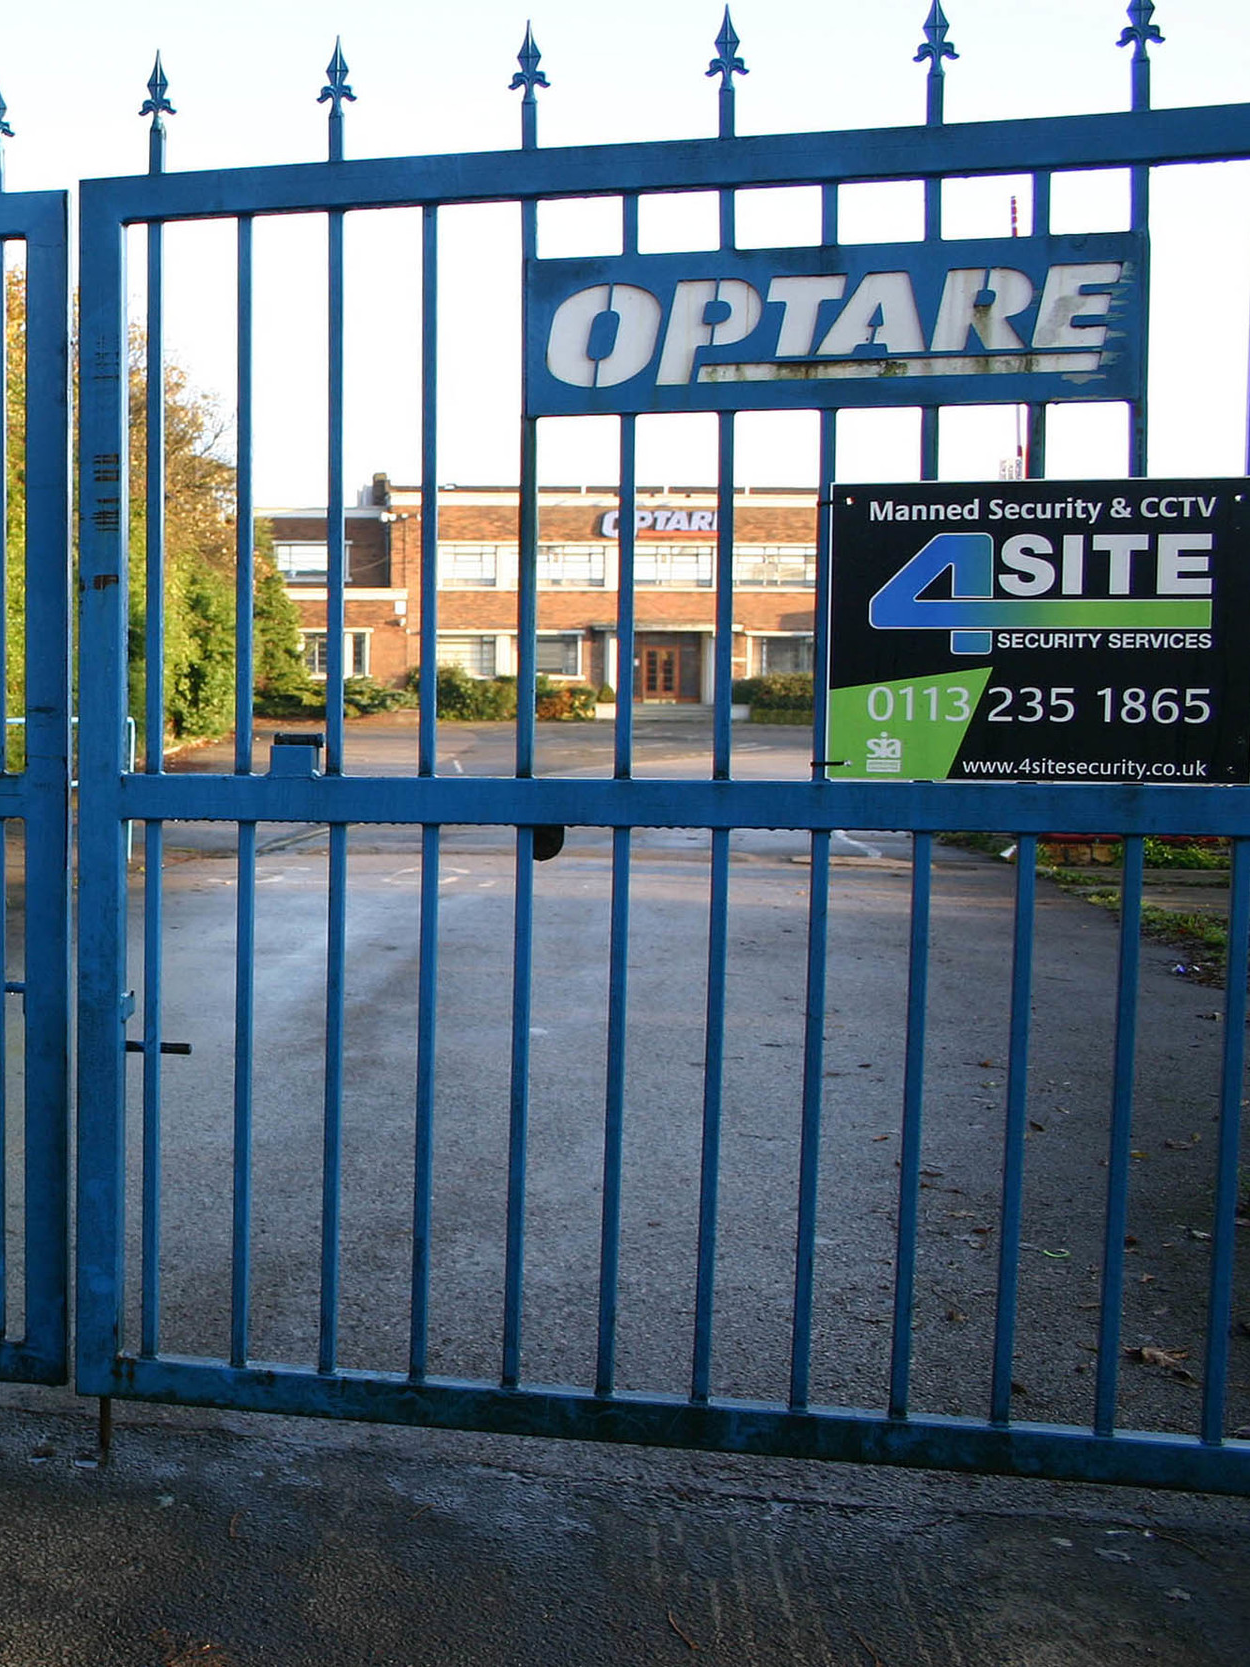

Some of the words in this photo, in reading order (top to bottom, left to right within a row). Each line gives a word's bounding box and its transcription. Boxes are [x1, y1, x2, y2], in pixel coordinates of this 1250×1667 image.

[545, 261, 1124, 388] OPTARE
[601, 510, 718, 538] OPTAR
[869, 499, 980, 522] Manned
[988, 498, 1102, 524] Security
[1109, 498, 1132, 519] &
[1140, 497, 1217, 518] CCTV
[997, 633, 1100, 650] SECURITY
[1108, 633, 1212, 650] SERVICES
[867, 686, 972, 723] 0113
[987, 687, 1075, 723] 235
[1096, 687, 1211, 724] 1865
[962, 758, 1207, 779] www.4sitesecurity.co.uk
